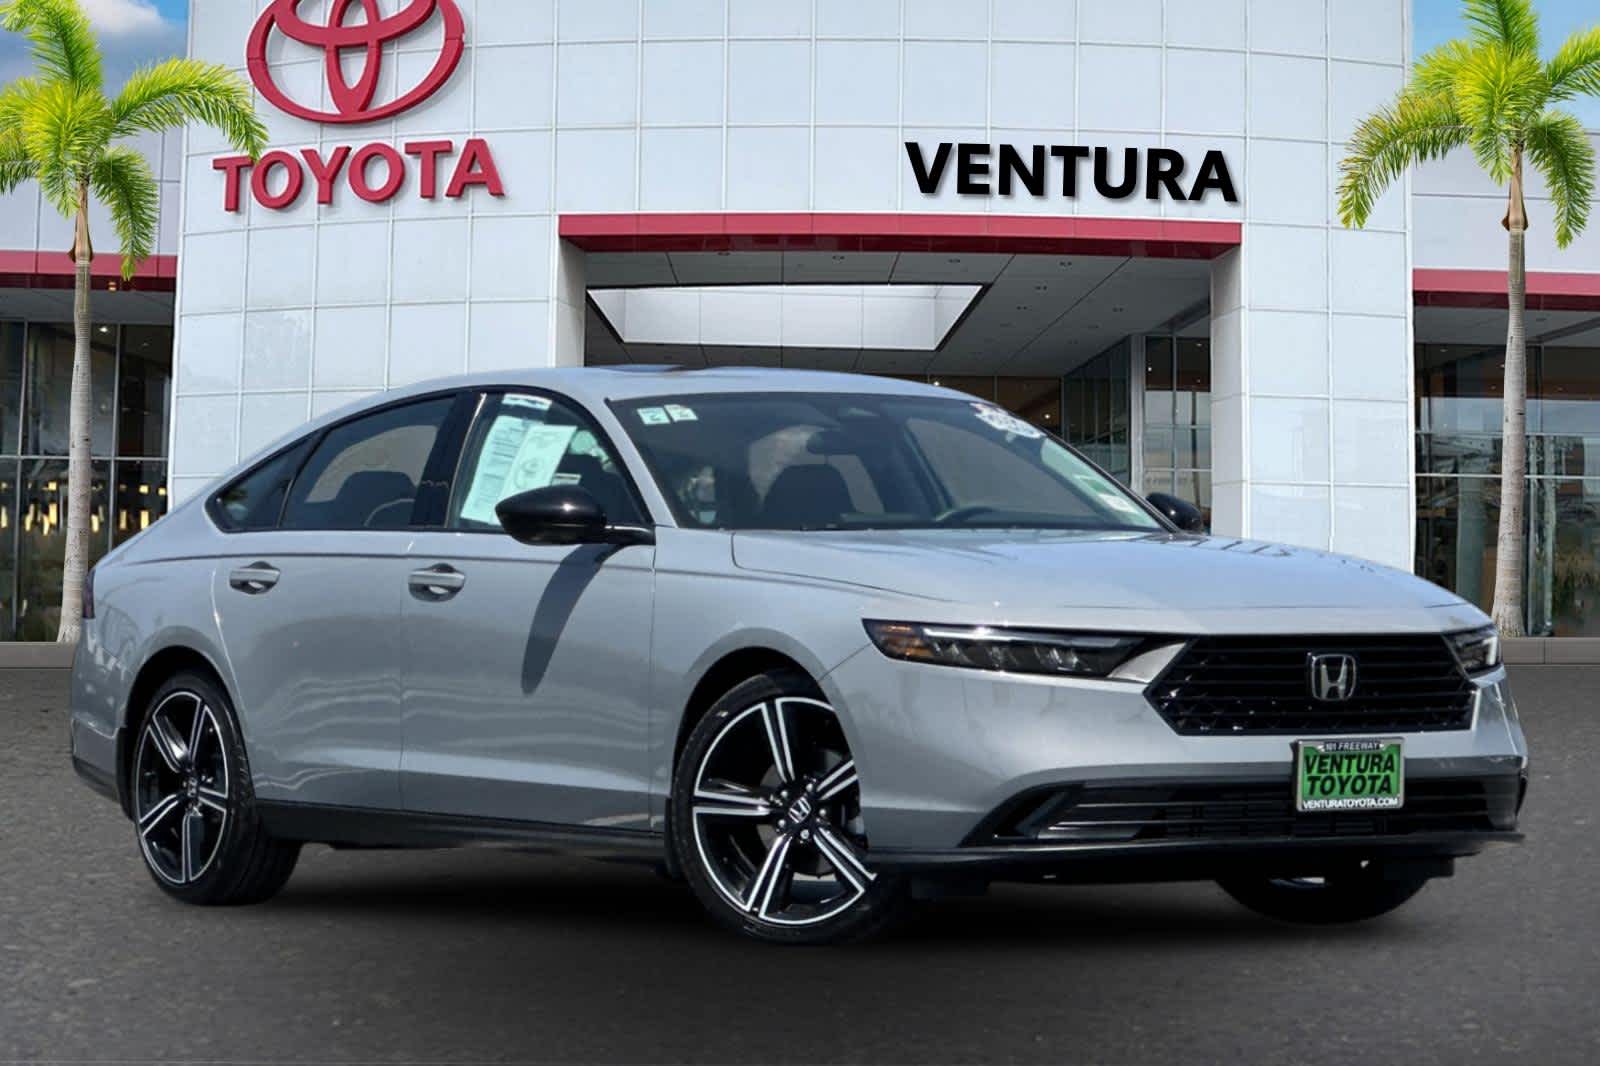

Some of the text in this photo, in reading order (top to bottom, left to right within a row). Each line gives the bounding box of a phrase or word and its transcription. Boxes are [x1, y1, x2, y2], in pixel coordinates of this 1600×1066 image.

[213, 138, 505, 212] TOYOTA
[904, 142, 1239, 203] VENTURA
[1338, 742, 1379, 751] FREEWAY
[1304, 753, 1395, 774] VENTURA
[1307, 775, 1393, 796] TOYOTA
[1303, 797, 1398, 809] VENTURATOYOTA.COM
